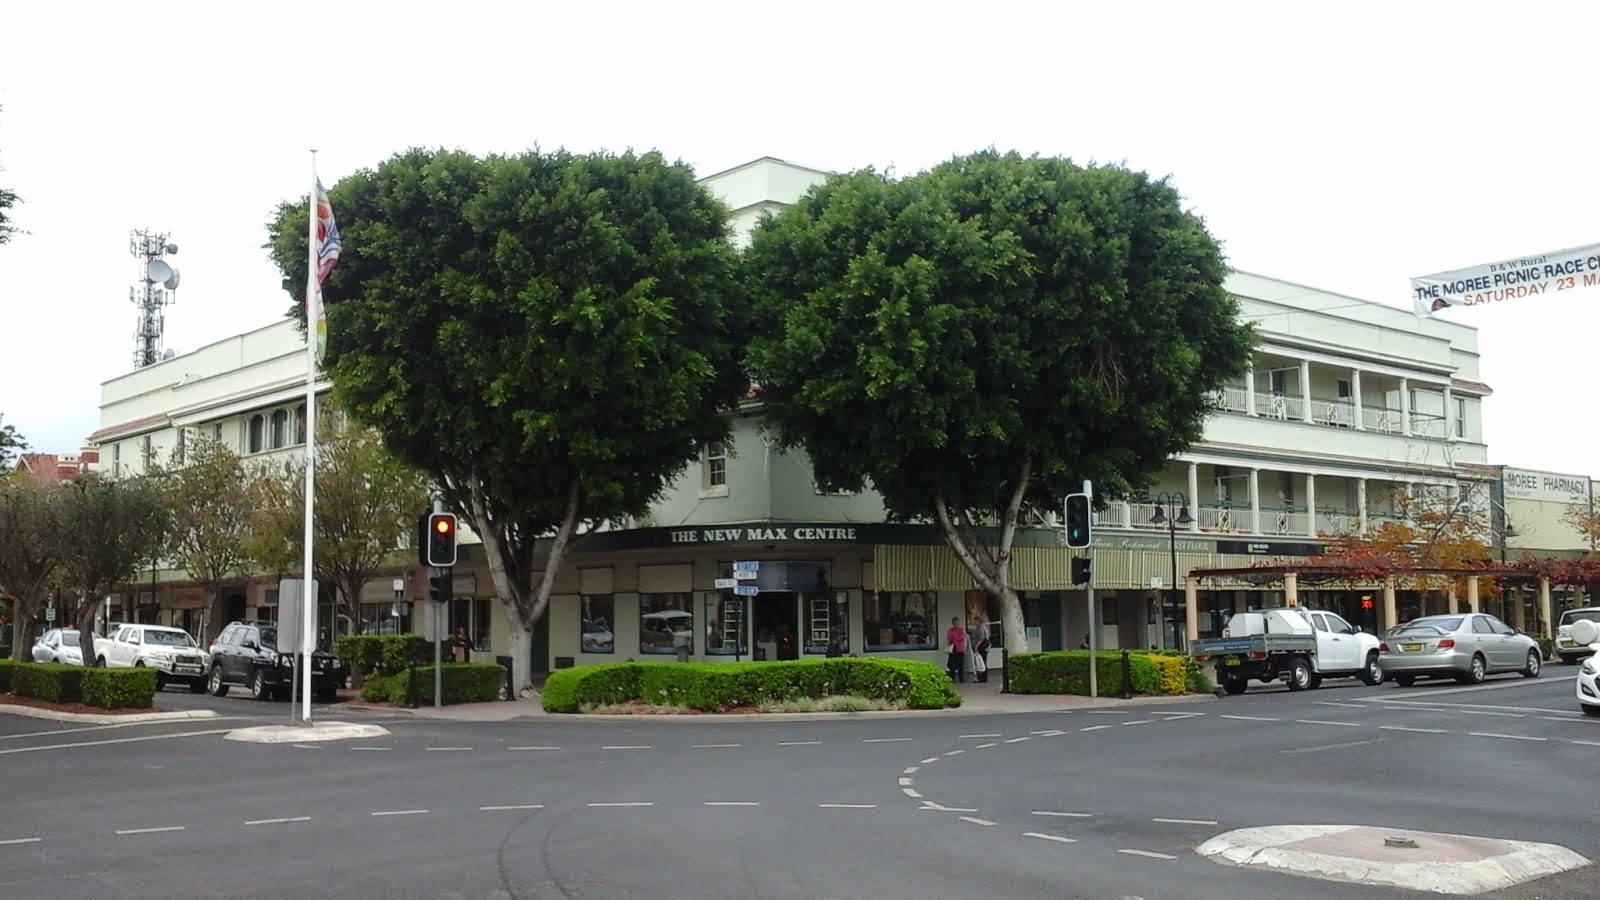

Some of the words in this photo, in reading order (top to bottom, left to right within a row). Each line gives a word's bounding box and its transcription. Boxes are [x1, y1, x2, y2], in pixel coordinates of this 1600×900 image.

[1490, 264, 1497, 273] B
[1507, 260, 1518, 269] W
[1520, 255, 1547, 267] Rural
[1415, 284, 1440, 300] THE
[1442, 275, 1491, 296] MOREE
[1494, 267, 1541, 287] PICNIC
[1544, 258, 1584, 279] RACE
[1464, 281, 1548, 306] SATURDAY
[1556, 276, 1575, 291] 23
[1583, 273, 1600, 288] M
[1507, 472, 1538, 490] MOREE
[1543, 477, 1585, 494] PHARMACY
[671, 530, 698, 543] THE
[703, 529, 742, 542] NEW
[747, 528, 788, 540] MAX
[793, 528, 857, 540] CENTRE
